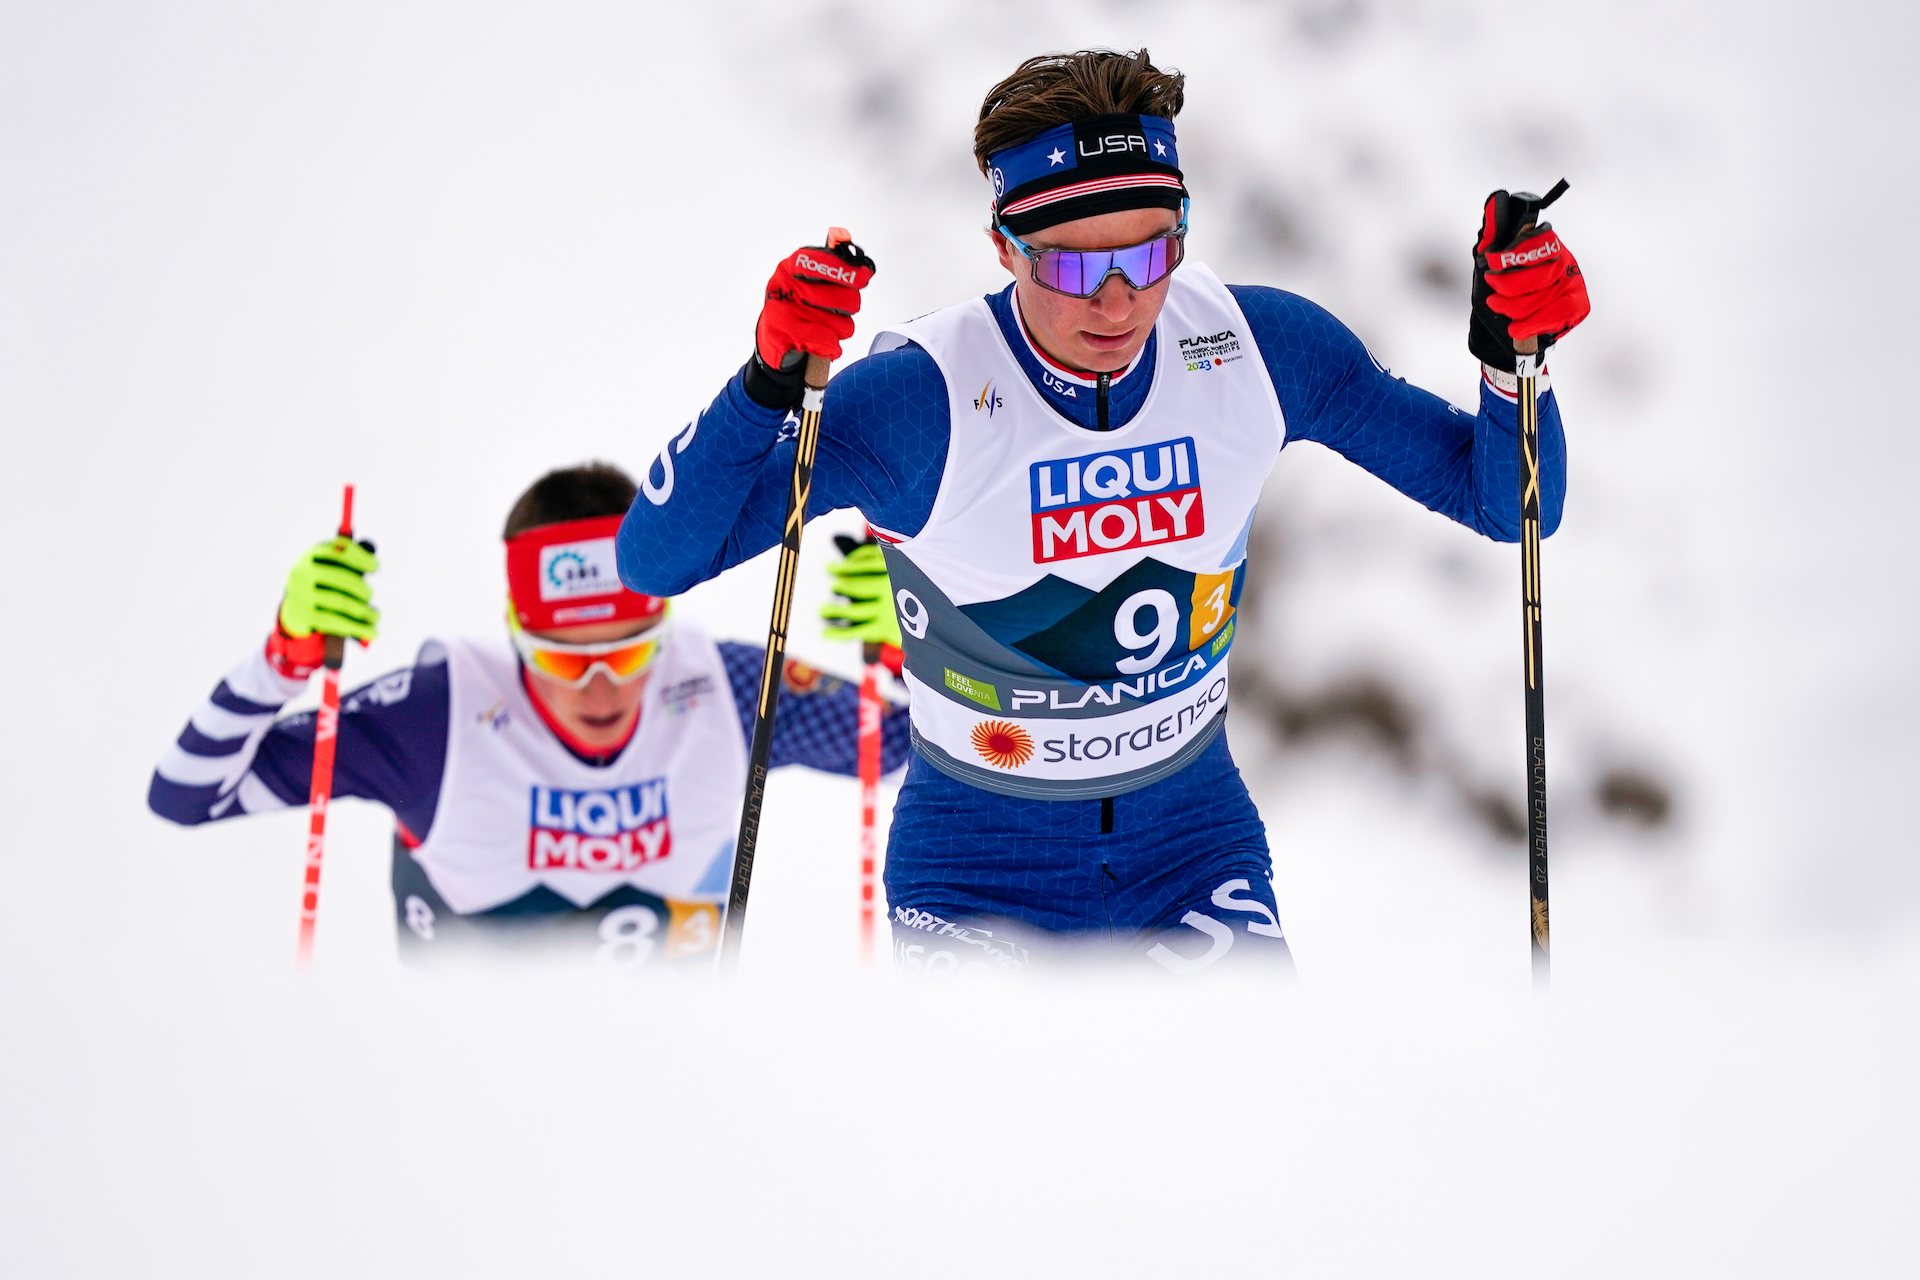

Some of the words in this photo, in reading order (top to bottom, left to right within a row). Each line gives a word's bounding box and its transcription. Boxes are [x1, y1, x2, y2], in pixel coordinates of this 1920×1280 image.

[1079, 135, 1147, 157] USA
[795, 253, 857, 285] Roeckl
[1500, 238, 1561, 268] Roeckl
[1179, 330, 1237, 349] PLANICA
[1184, 345, 1240, 361] CHAMPIONSHIPS
[1191, 346, 1210, 355] NORDIC
[1210, 343, 1229, 352] WORLD
[1042, 371, 1078, 399] USA
[1186, 359, 1212, 371] 2023
[1037, 442, 1192, 509] LIQUI
[1040, 492, 1199, 559] MOLY
[896, 588, 929, 639] 9
[1113, 588, 1180, 675] 9
[1201, 583, 1225, 635] 3
[947, 678, 991, 701] SLOVENIA
[951, 673, 972, 687] FEEL
[1011, 653, 1207, 711] PLANICA
[1533, 736, 1546, 785] BLACK
[537, 784, 664, 836] LIQUI
[748, 763, 767, 814] BLACK
[1534, 787, 1547, 858] FEATHER
[534, 824, 669, 870] MOLY
[737, 817, 760, 888] FEATHER
[1536, 865, 1547, 884] 2.0
[595, 903, 660, 972] 8
[681, 908, 712, 953] 3
